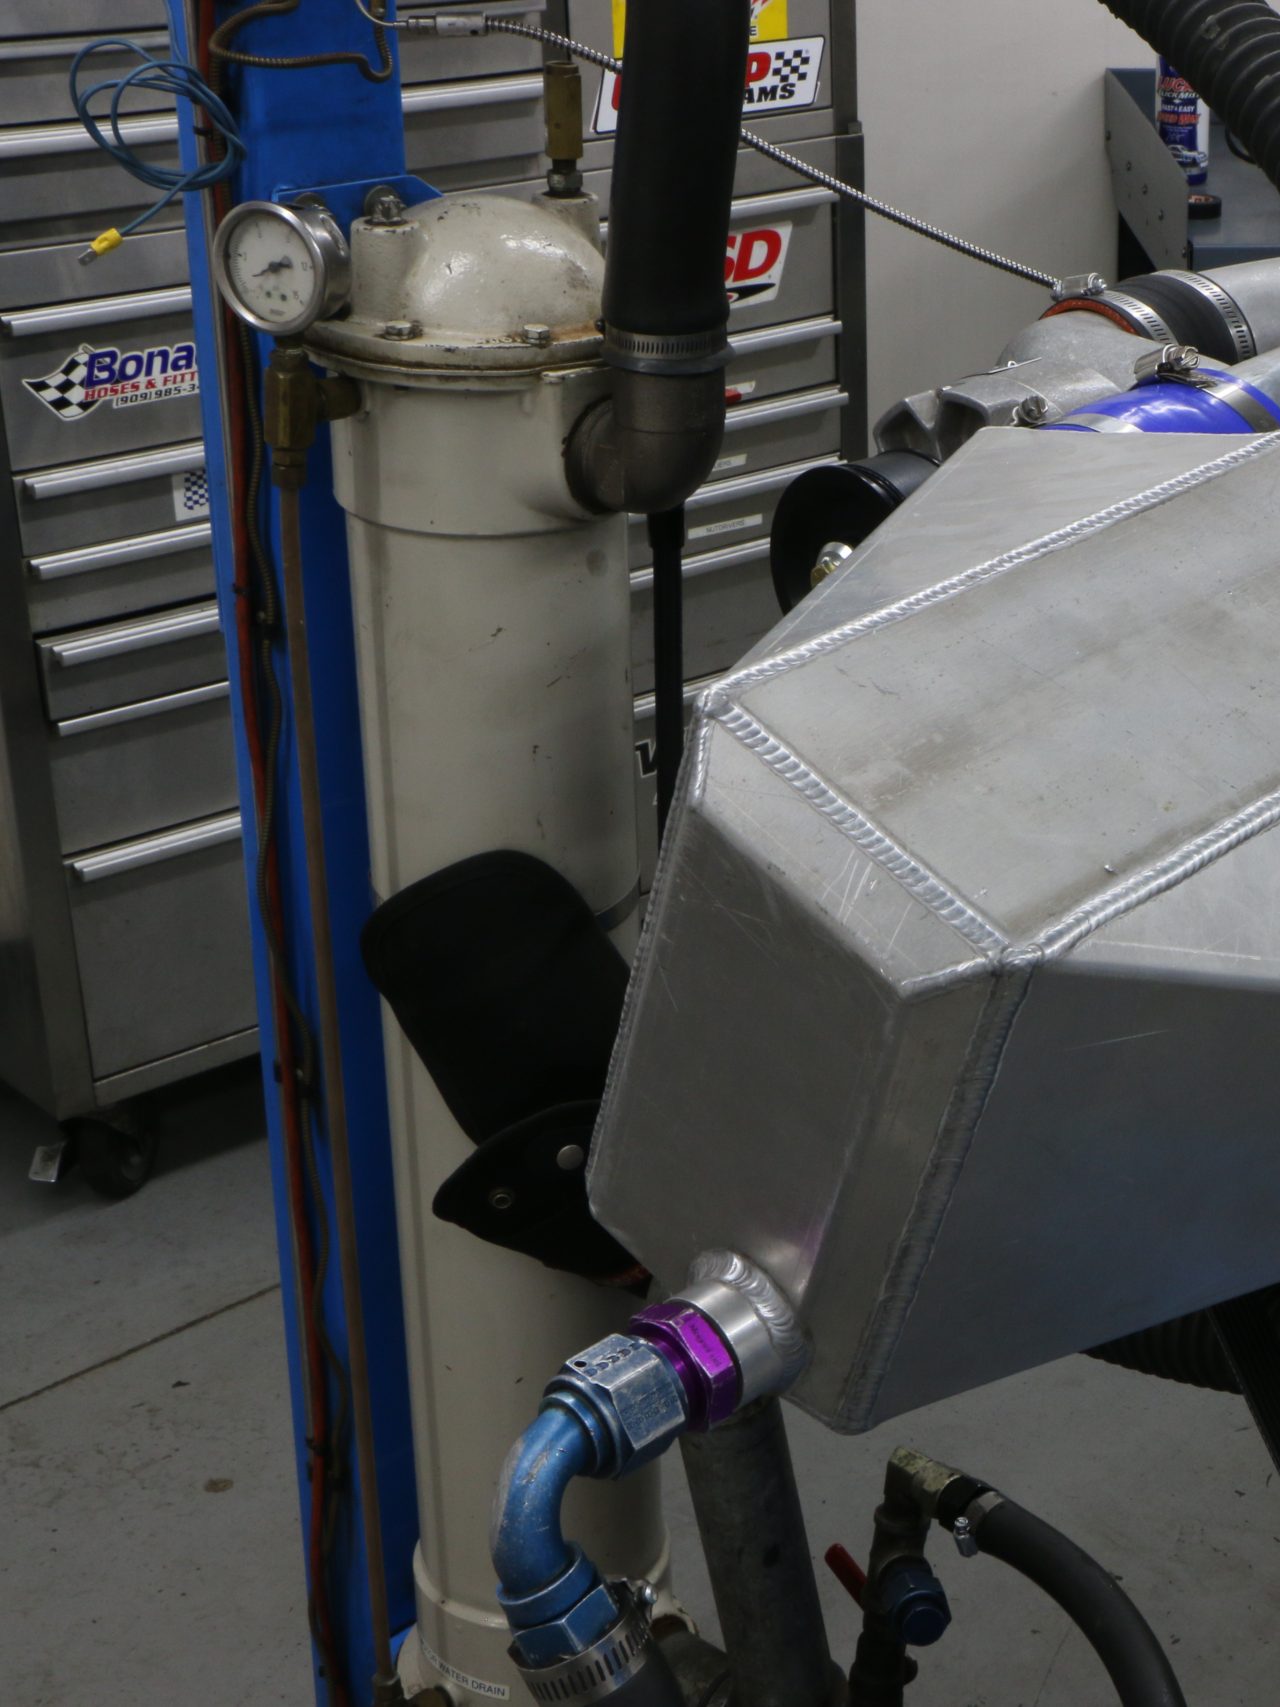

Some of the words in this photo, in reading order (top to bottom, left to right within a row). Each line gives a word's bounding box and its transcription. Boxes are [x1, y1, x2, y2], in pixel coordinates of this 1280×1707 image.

[743, 82, 797, 105] AMS
[1178, 105, 1196, 113] EASY
[83, 379, 141, 401] HOSES
[144, 377, 159, 390] &
[438, 1661, 469, 1686] WATER
[471, 1679, 506, 1698] DRAIN
